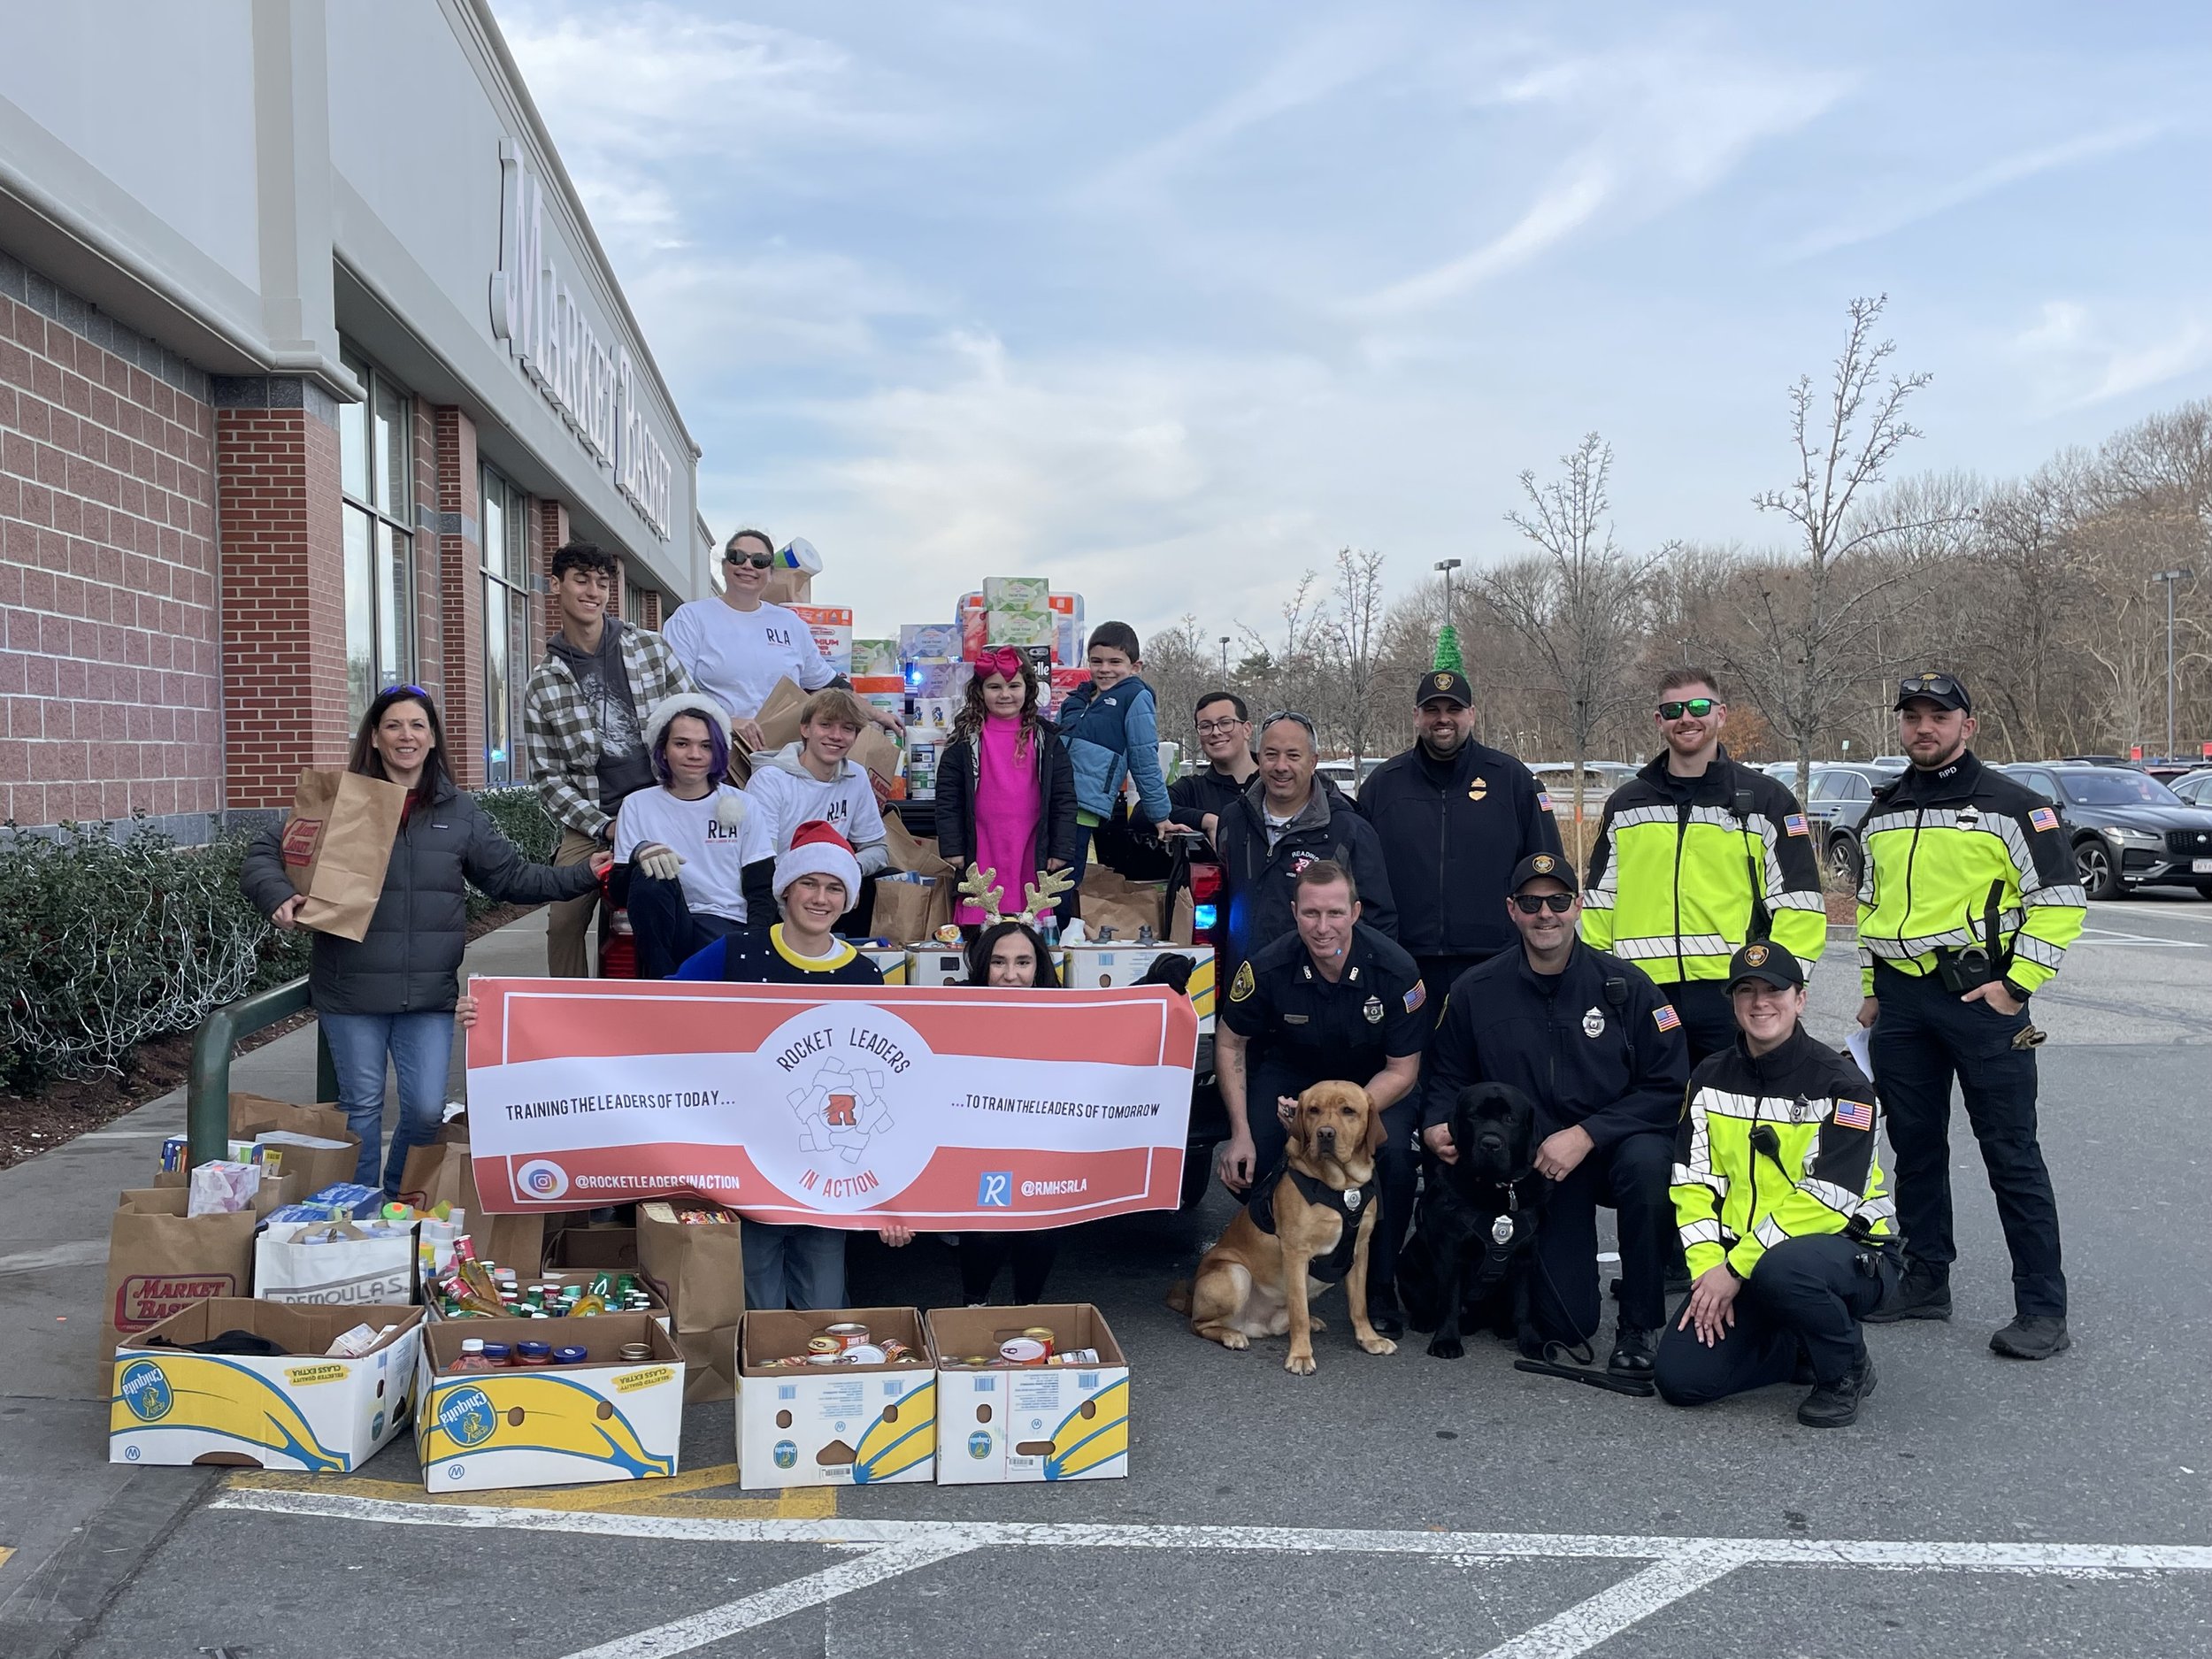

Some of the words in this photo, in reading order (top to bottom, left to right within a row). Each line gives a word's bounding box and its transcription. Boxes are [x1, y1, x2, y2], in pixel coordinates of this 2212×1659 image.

[765, 627, 791, 646] RLA
[1939, 766, 1957, 779] RPD
[826, 799, 847, 821] RLA
[708, 819, 737, 839] RLA
[776, 1028, 833, 1072] ROCKET
[849, 1027, 910, 1073] LEADERS
[505, 1099, 569, 1121] TRAINING
[570, 1096, 596, 1114] THE
[597, 1094, 657, 1110] LEADERS
[657, 1094, 672, 1109] OF
[982, 1096, 1016, 1112] TRAIN
[1085, 1104, 1100, 1118] OF
[1102, 1103, 1160, 1119] TOMORROW
[575, 1175, 740, 1189] @ROCKETLEADERSINACTION
[799, 1169, 819, 1191] IN
[822, 1170, 879, 1198] ACTION
[1021, 1179, 1087, 1197] @RMHSRLA
[133, 1279, 226, 1299] MARKET
[137, 1300, 194, 1318] BAS
[122, 1368, 164, 1394] Chiquita
[439, 1391, 488, 1424] Chiquita
